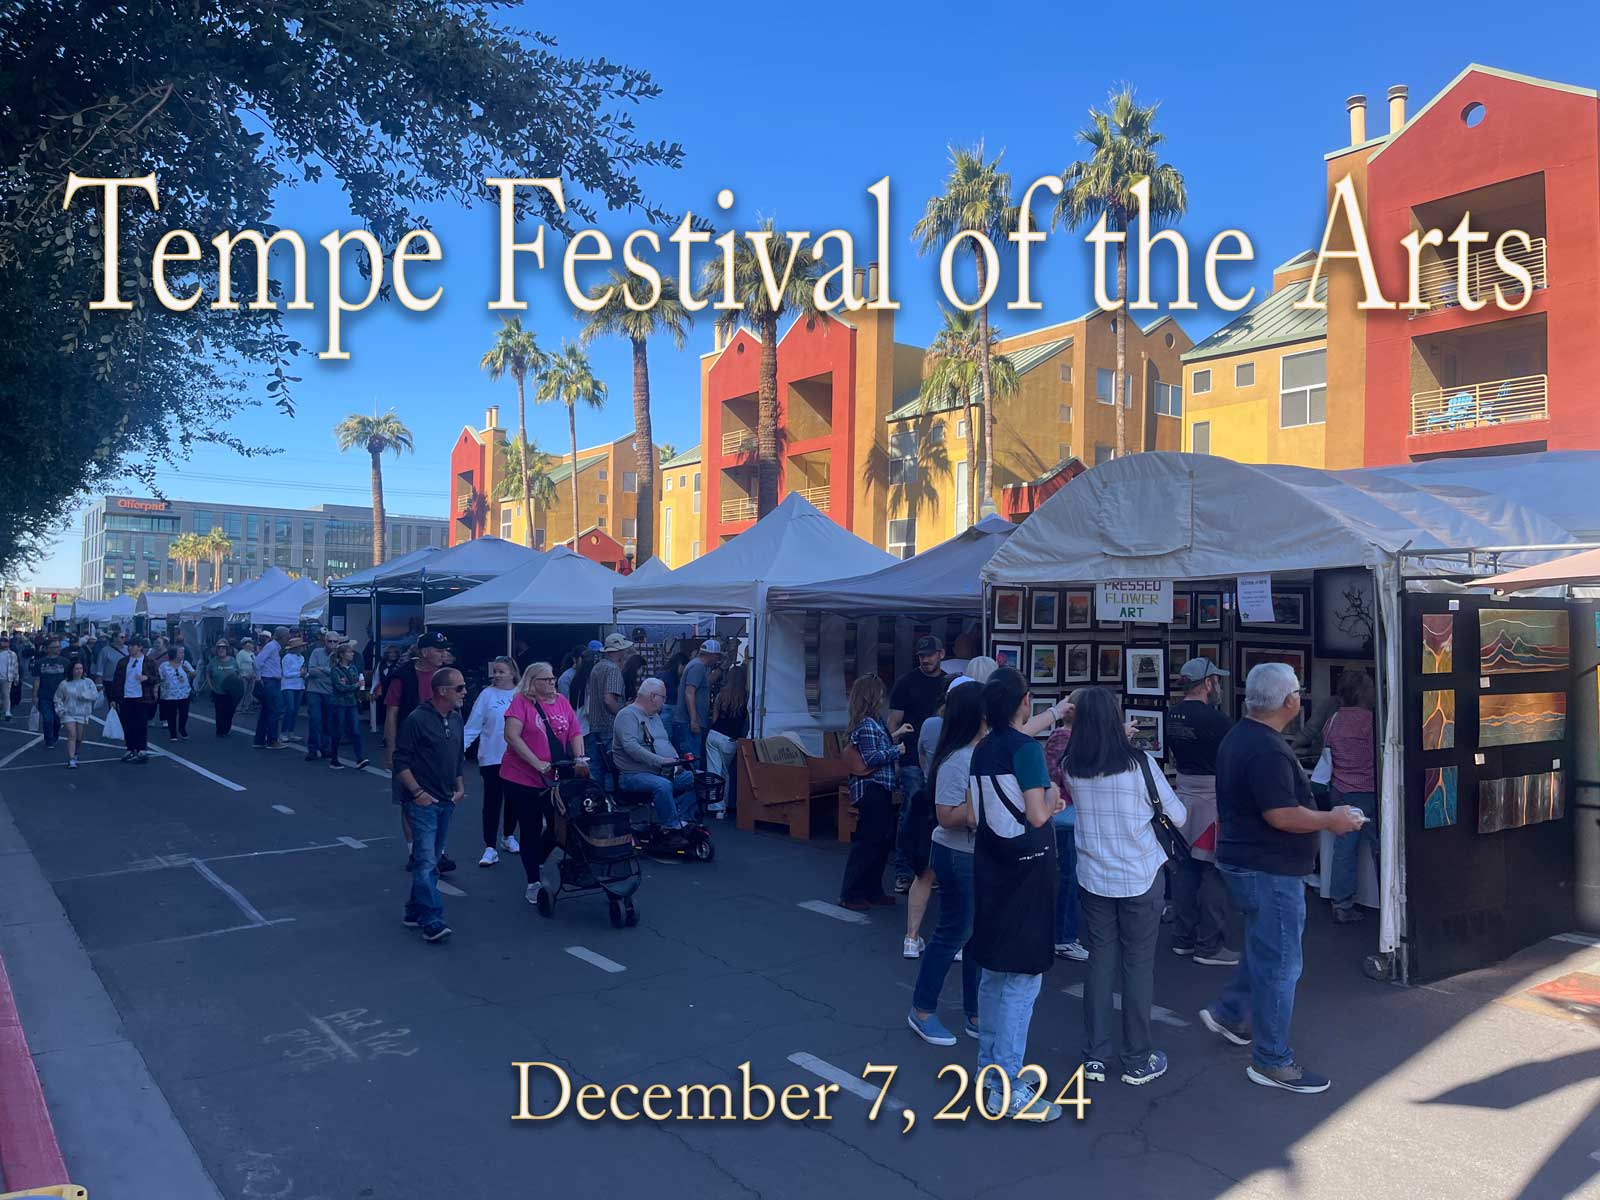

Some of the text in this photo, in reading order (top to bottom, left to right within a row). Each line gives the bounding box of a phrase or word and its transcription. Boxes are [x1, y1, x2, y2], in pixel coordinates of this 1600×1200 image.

[1104, 580, 1161, 592] PRESSED
[1105, 592, 1160, 606] FLOWER
[1119, 607, 1145, 618] ART
